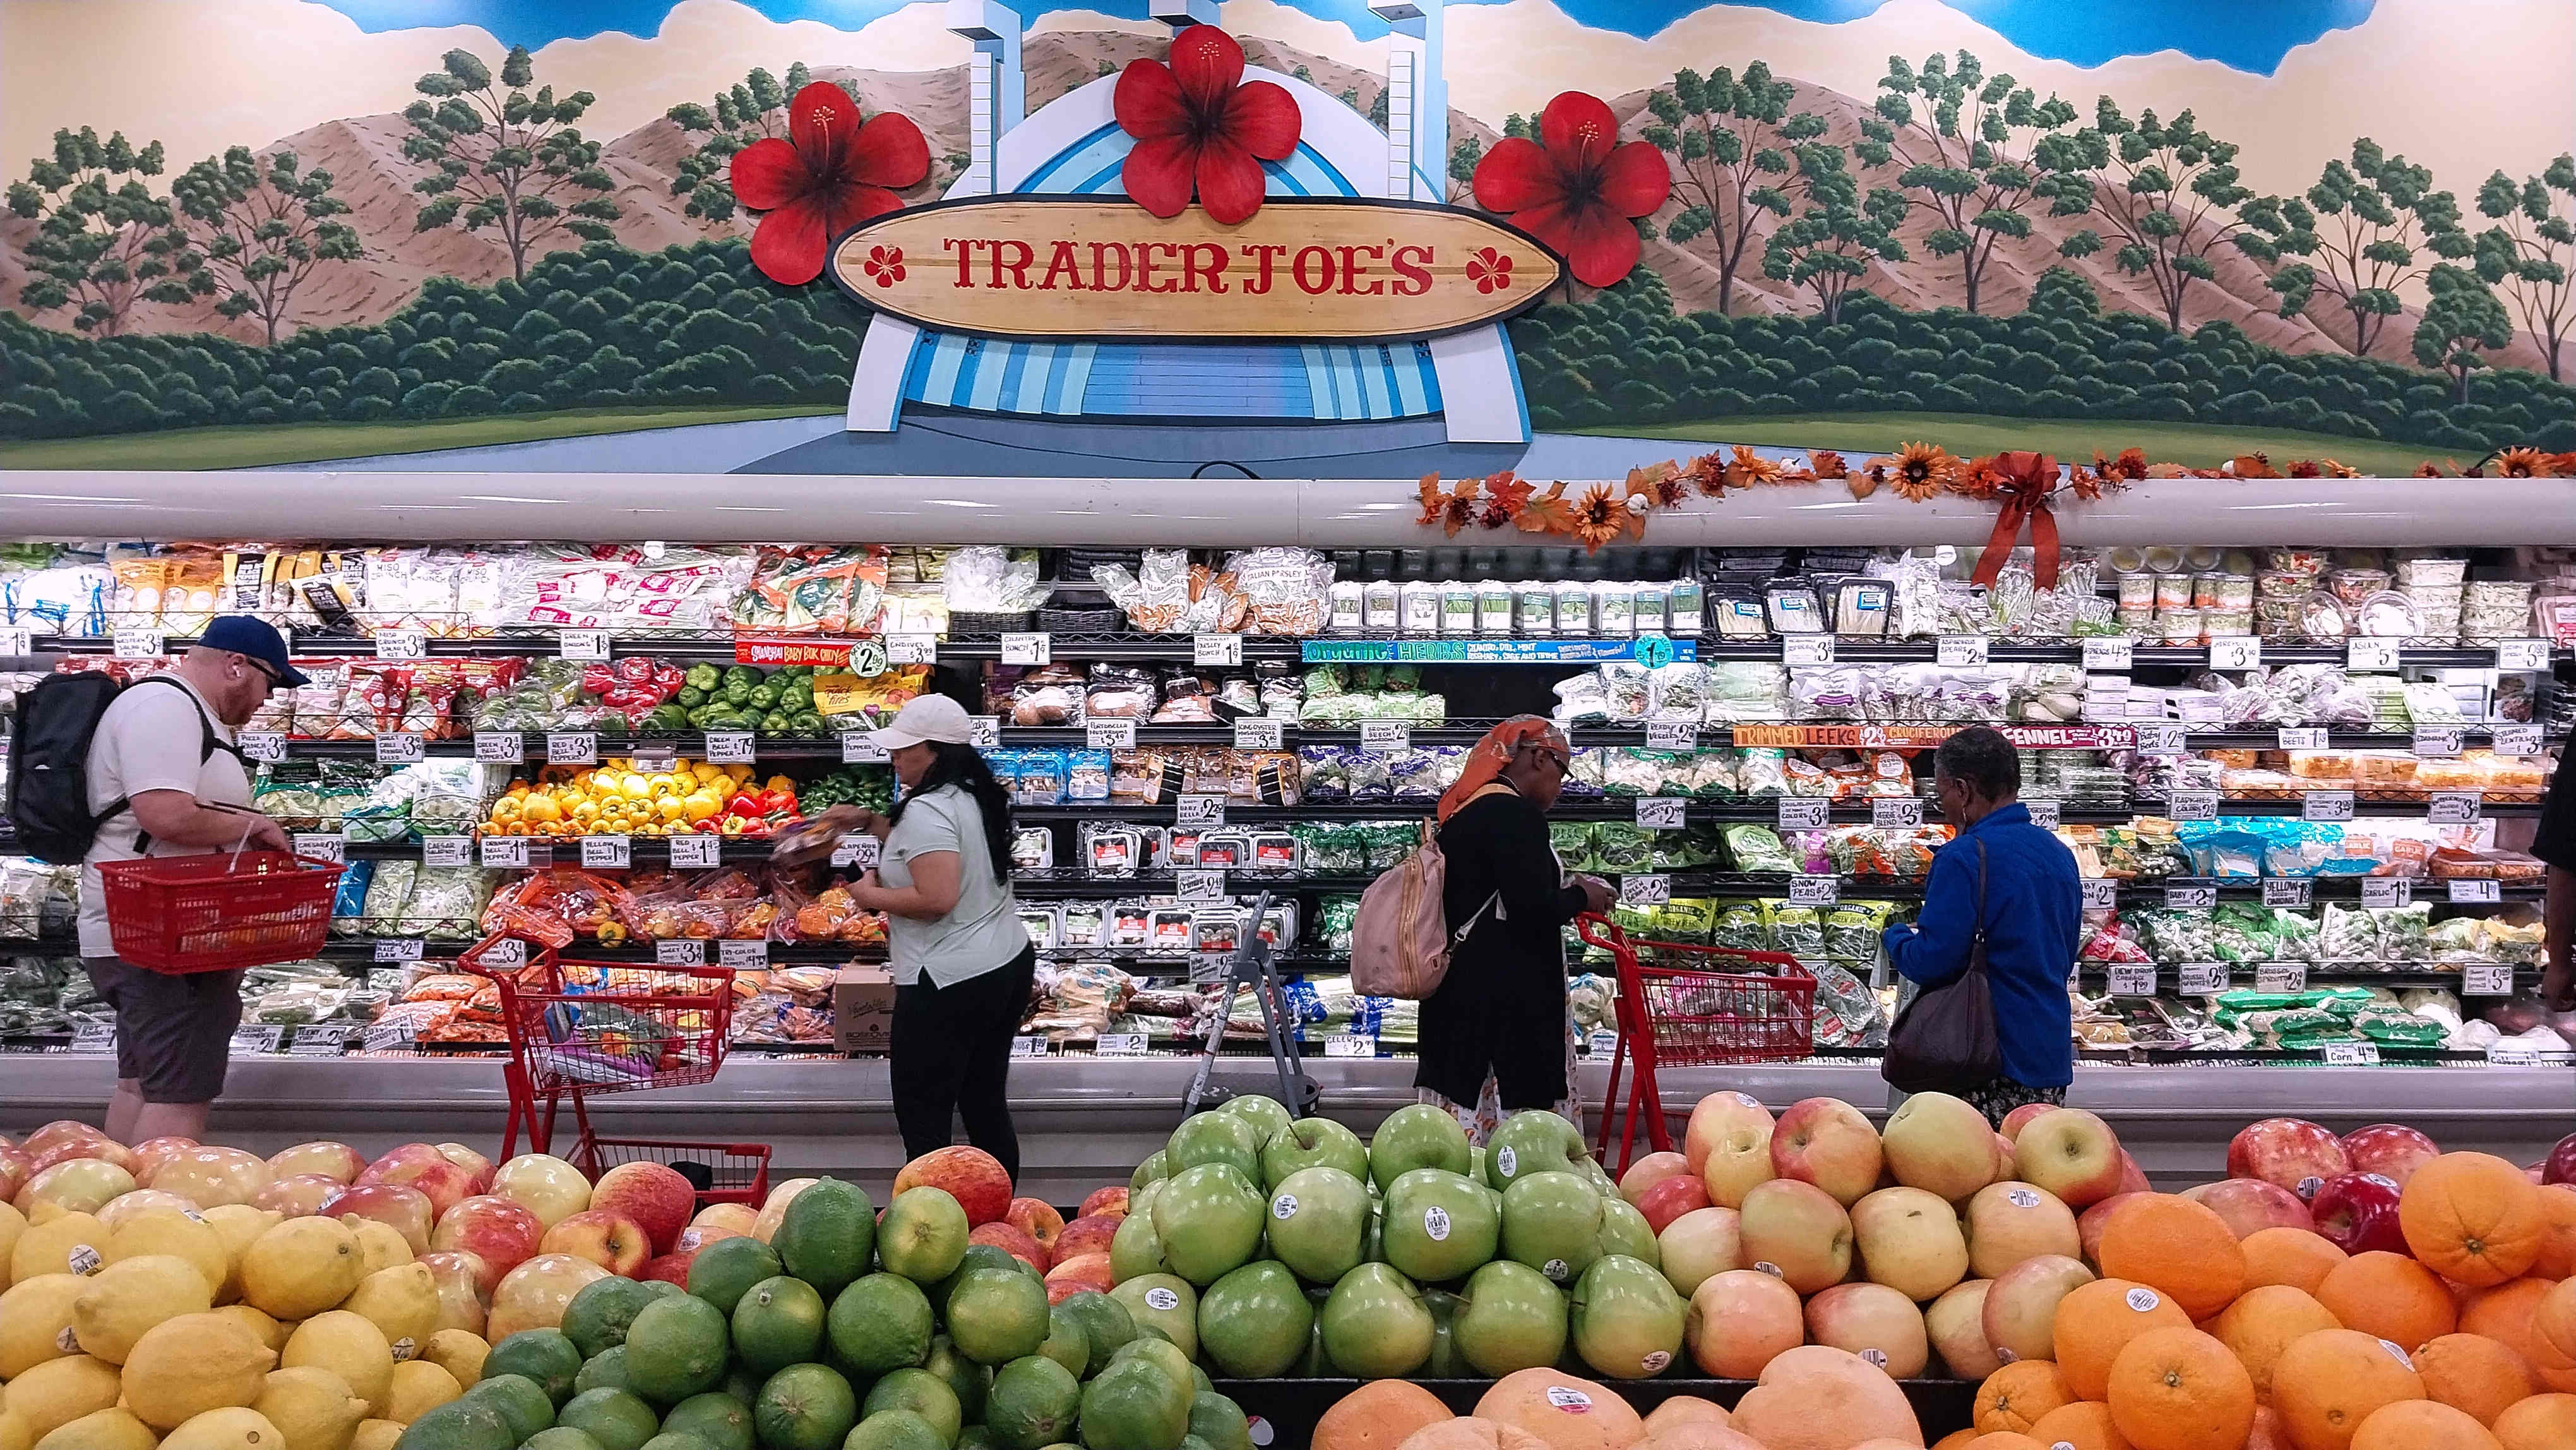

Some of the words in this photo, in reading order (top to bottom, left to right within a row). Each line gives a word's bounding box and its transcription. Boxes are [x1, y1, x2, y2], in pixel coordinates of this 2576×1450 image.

[942, 238, 1229, 294] TRADER
[1242, 238, 1434, 296] JOE'S
[784, 647, 802, 662] BABY
[1308, 642, 1388, 661] Organic
[1397, 643, 1465, 661] HERBS
[1734, 728, 1804, 745] TRIMMED
[1806, 728, 1855, 745] LEEKS
[2394, 845, 2423, 855] GARLIC
[2267, 882, 2298, 892] YELLOW
[1792, 889, 1815, 897] PEAS
[1667, 906, 1695, 914] ORGANIC
[1839, 904, 1865, 913] ORGANIC
[2331, 1053, 2352, 1061] Corn
